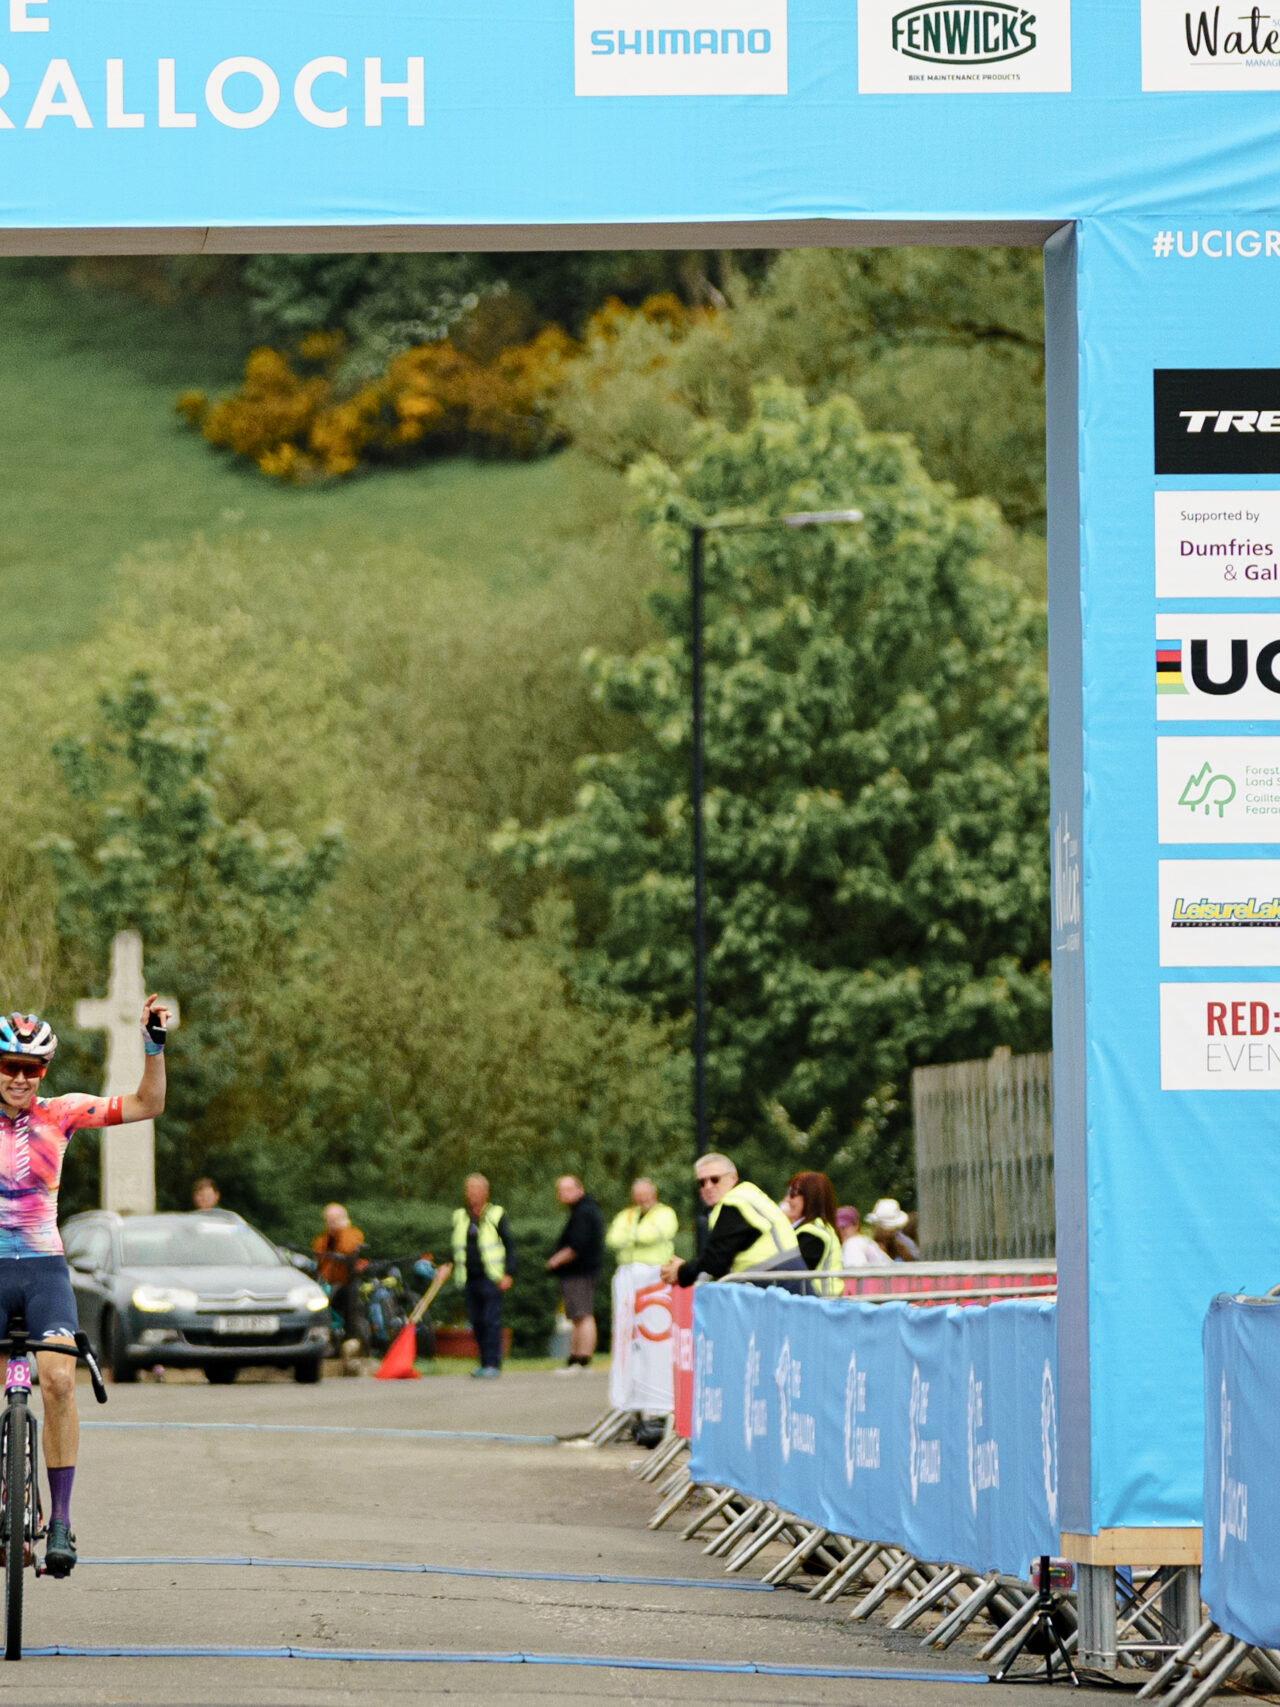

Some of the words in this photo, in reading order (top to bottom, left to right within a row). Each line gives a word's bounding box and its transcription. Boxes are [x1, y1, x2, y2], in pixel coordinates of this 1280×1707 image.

[892, 9, 1037, 55] FENWICK'S
[591, 29, 772, 56] SHIMANO
[1180, 510, 1242, 523] Supported
[1245, 510, 1260, 523] by
[1180, 539, 1273, 557] Dumfries
[1224, 564, 1237, 581] &
[1244, 564, 1277, 581] Gal
[1245, 777, 1273, 787] Land
[1245, 805, 1280, 816] Feara
[15, 1115, 31, 1181] CANYON
